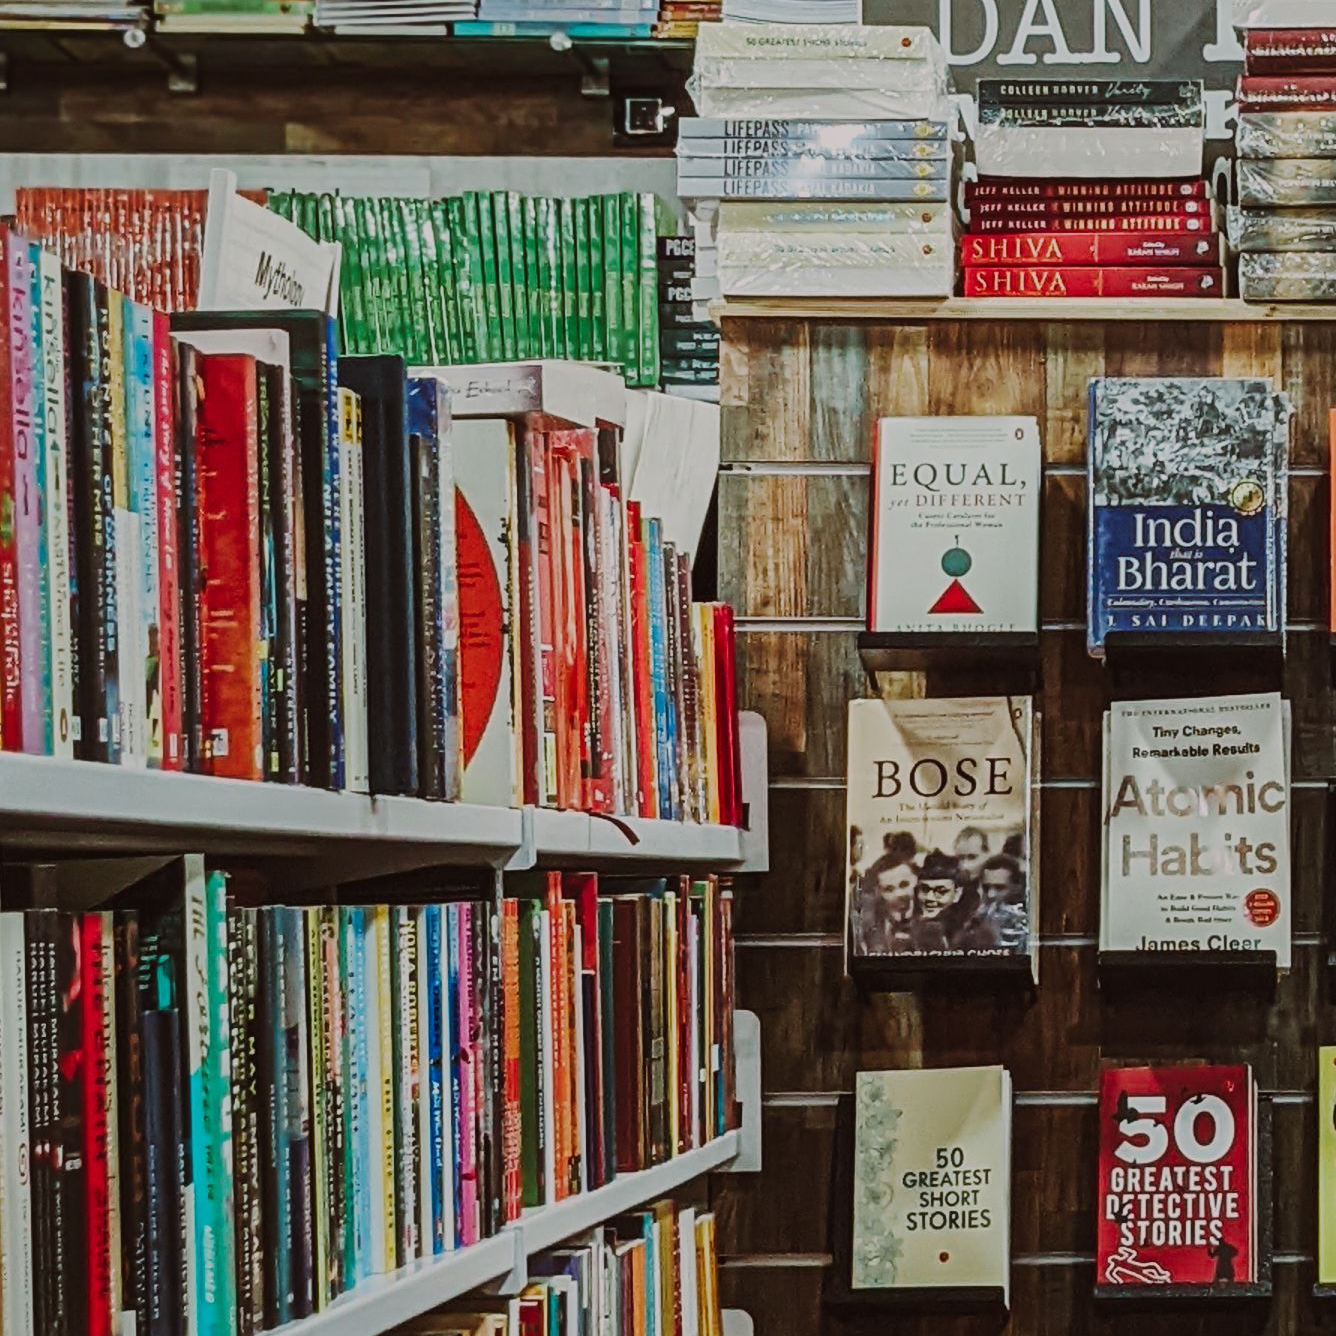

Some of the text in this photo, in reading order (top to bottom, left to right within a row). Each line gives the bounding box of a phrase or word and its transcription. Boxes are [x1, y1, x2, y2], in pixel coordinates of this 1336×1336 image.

[724, 119, 789, 138] LIFEPASS
[972, 236, 1063, 260] SHIVA
[891, 463, 1027, 490] EQUAL,
[916, 494, 1026, 507] DIFFERENT
[1133, 512, 1240, 550] India
[1117, 556, 1257, 591] Bharat
[1152, 725, 1242, 738] Tiny Changes,
[1132, 742, 1260, 758] Remarkable Results
[872, 756, 1013, 798] BOSE
[1111, 771, 1286, 816] Atomic
[1122, 833, 1278, 877] Habits
[1135, 935, 1262, 951] James Clear
[1115, 1094, 1235, 1164] 50
[936, 1147, 964, 1168] 50
[902, 1169, 991, 1188] GREATEST
[1110, 1166, 1233, 1194] GREATEST
[919, 1191, 979, 1208] SHORT
[1106, 1193, 1239, 1220] DETECTIVE
[906, 1210, 991, 1231] STORIES
[1120, 1219, 1223, 1247] STORIES
